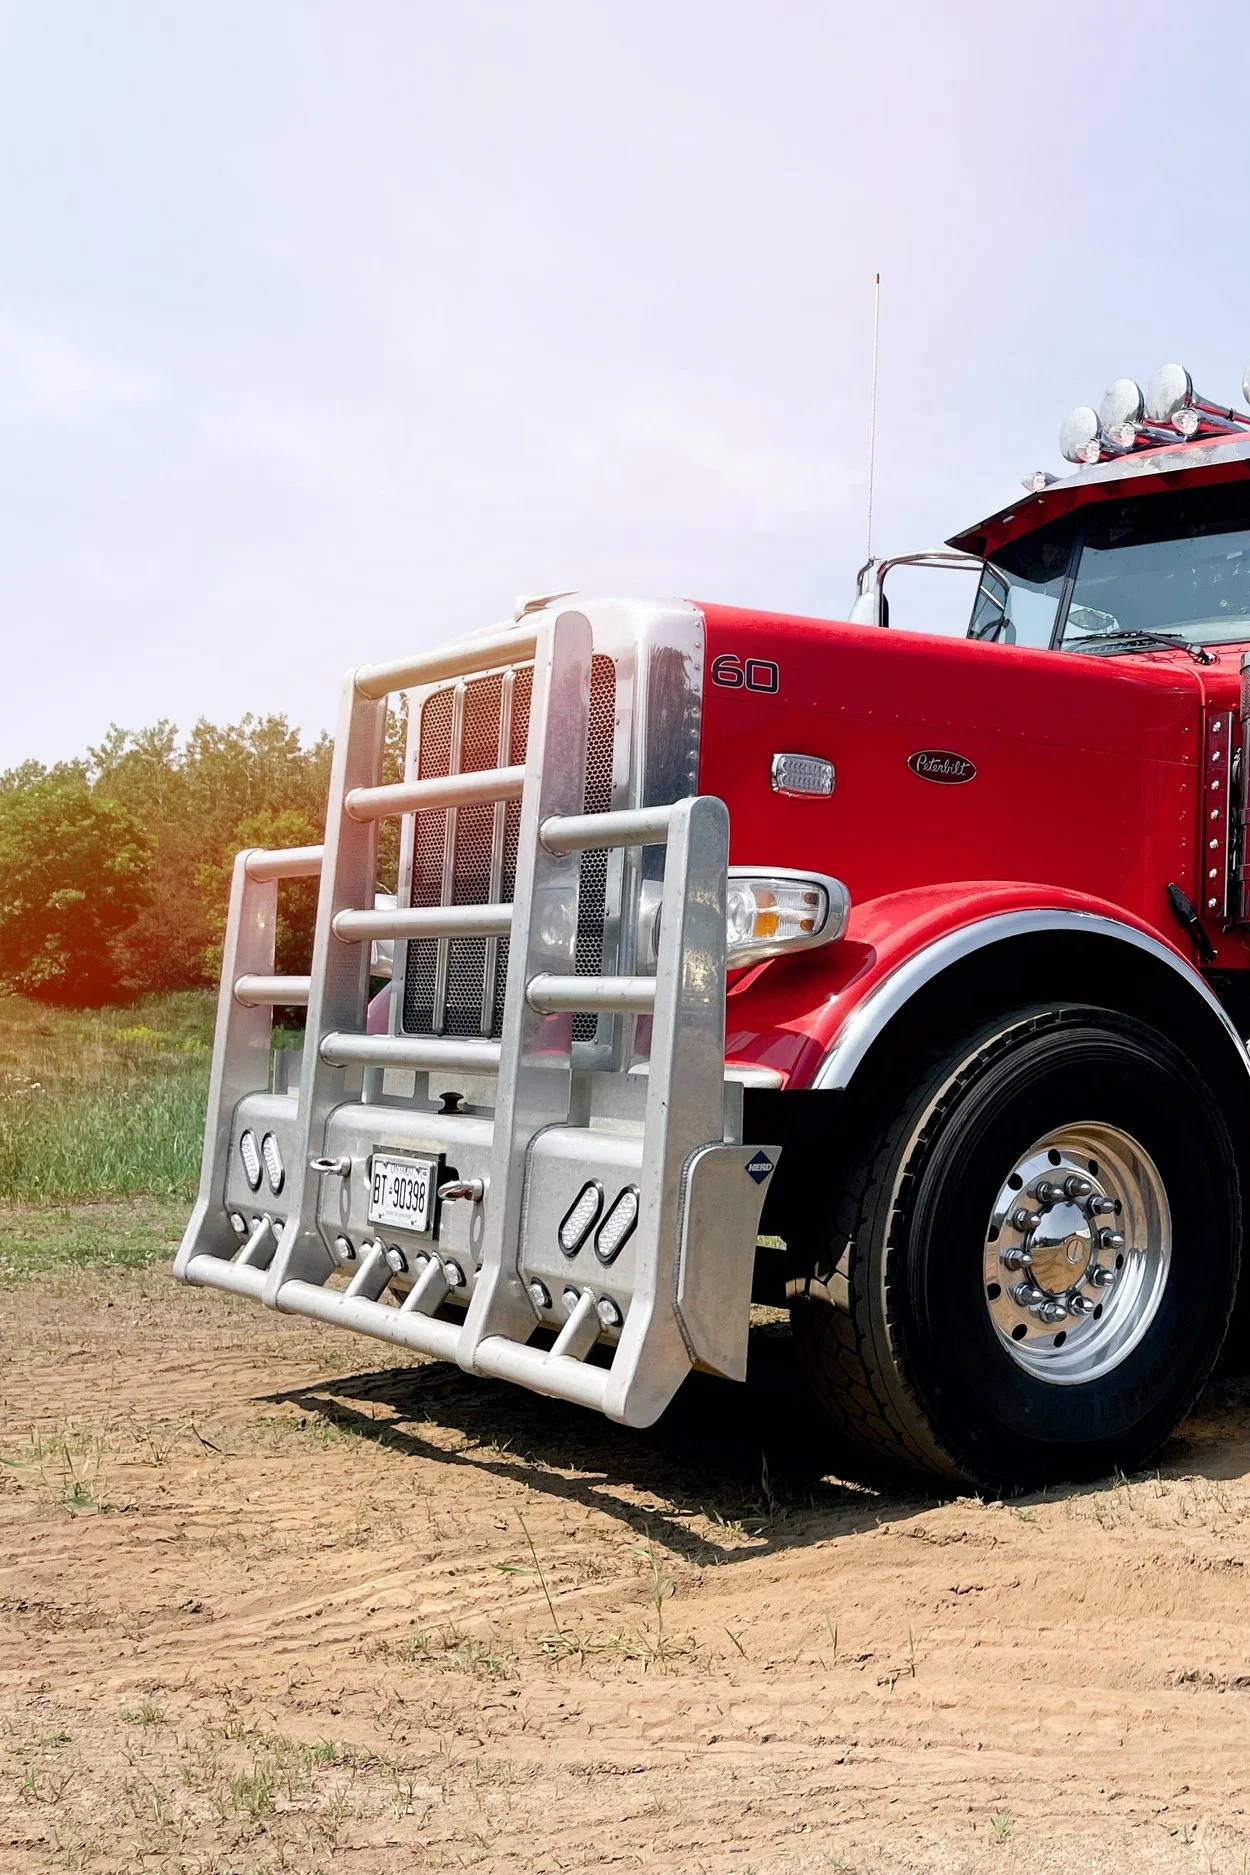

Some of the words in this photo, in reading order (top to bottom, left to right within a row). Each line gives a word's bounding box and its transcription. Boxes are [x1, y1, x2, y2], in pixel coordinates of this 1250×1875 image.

[711, 654, 779, 694] 60
[916, 754, 971, 776] Peterbilt
[748, 1163, 773, 1172] HERD
